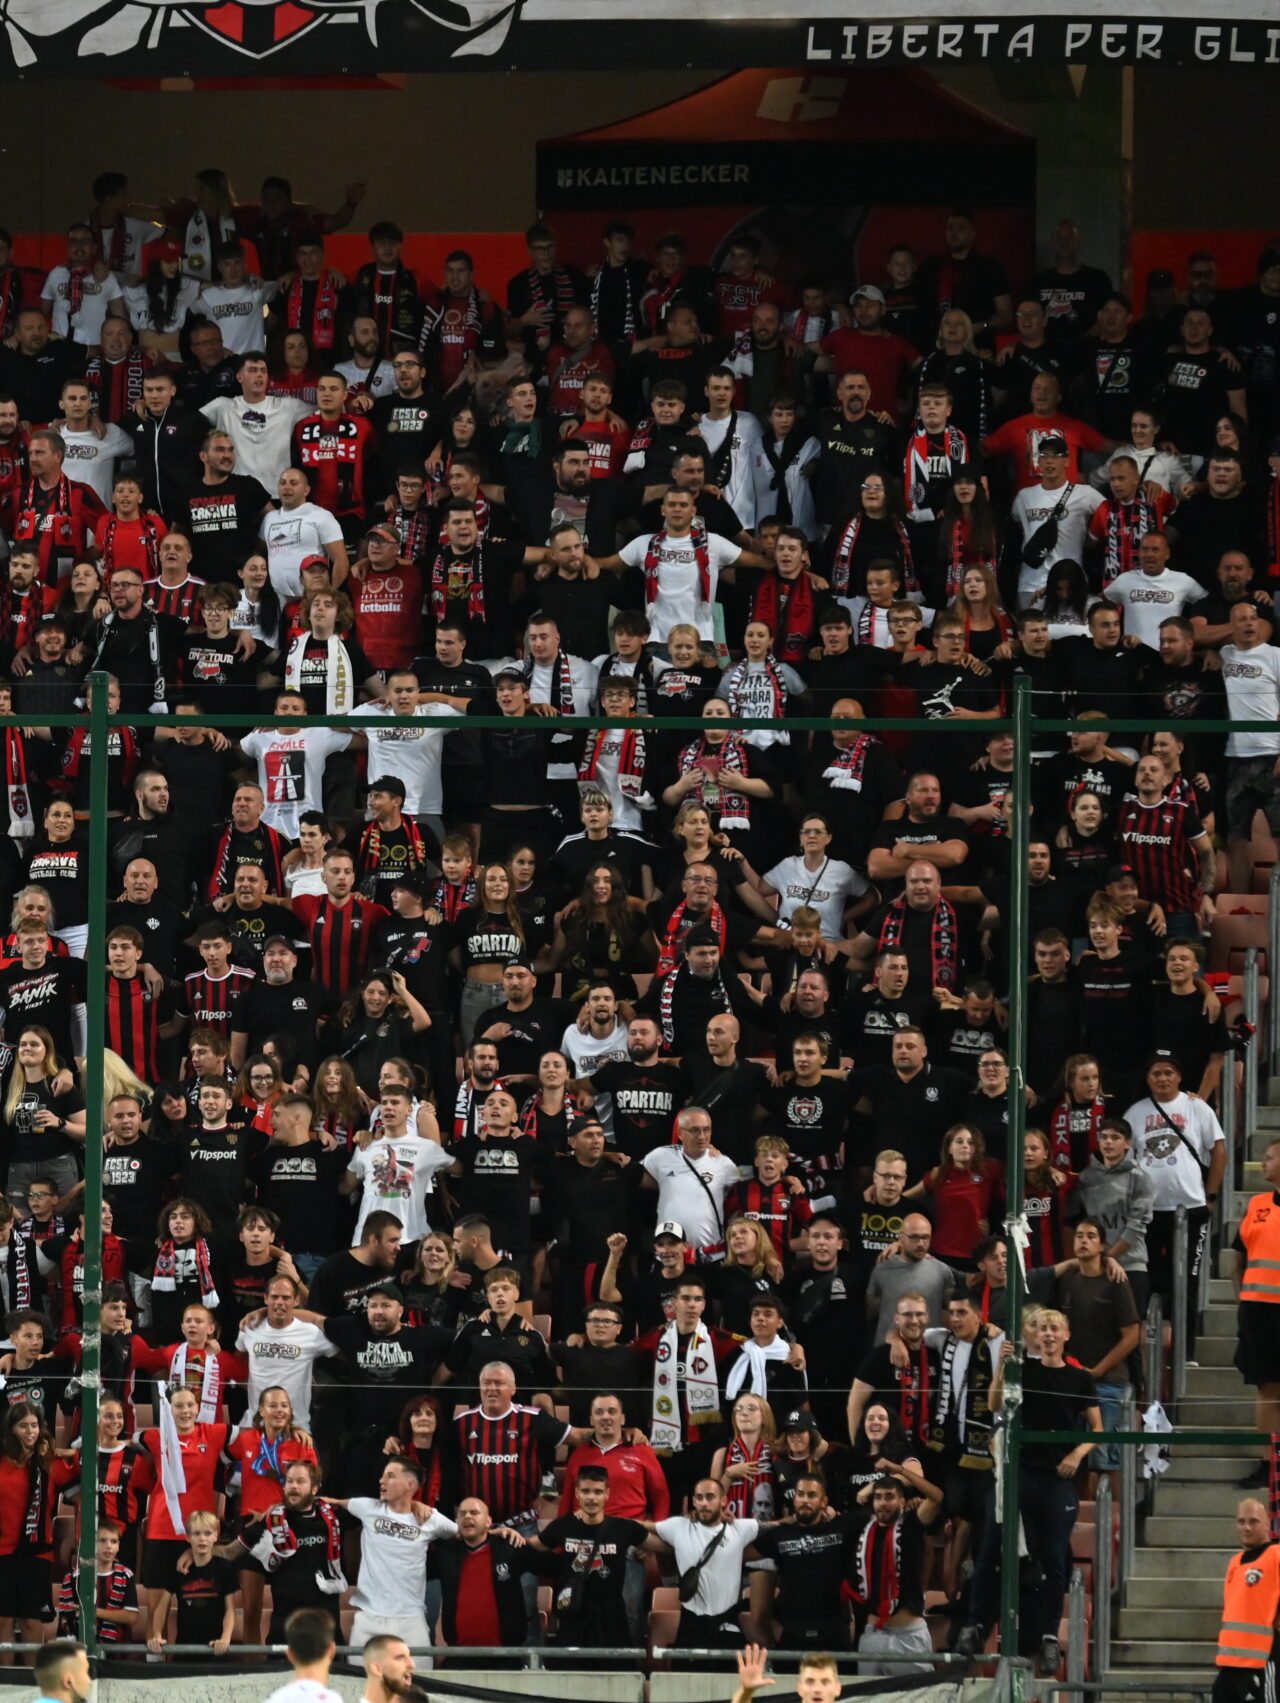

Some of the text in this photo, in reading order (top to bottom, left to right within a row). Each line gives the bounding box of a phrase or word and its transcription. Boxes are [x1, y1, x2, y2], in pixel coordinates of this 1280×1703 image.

[805, 23, 1036, 61] LIBERTA
[1064, 23, 1163, 60] PER
[576, 163, 751, 188] KALTENECKER
[392, 408, 419, 421] FCST
[399, 420, 424, 432] 1923
[1132, 590, 1170, 601] 1923
[209, 653, 235, 665] TOUR
[1131, 832, 1172, 846] Tipsport
[467, 933, 522, 955] SPARTAK
[9, 983, 58, 1009] BANÍK
[201, 1009, 233, 1022] Tipspo
[616, 1090, 673, 1111] SPARTAK
[199, 1149, 238, 1161] Tipsport
[104, 1157, 131, 1170] FCST
[110, 1170, 137, 1184] 1923
[256, 1343, 299, 1357] 1923
[476, 1453, 519, 1466] Tipsport
[851, 1472, 885, 1486] Tipspo
[98, 1483, 124, 1495] sport
[565, 1542, 578, 1554] ON
